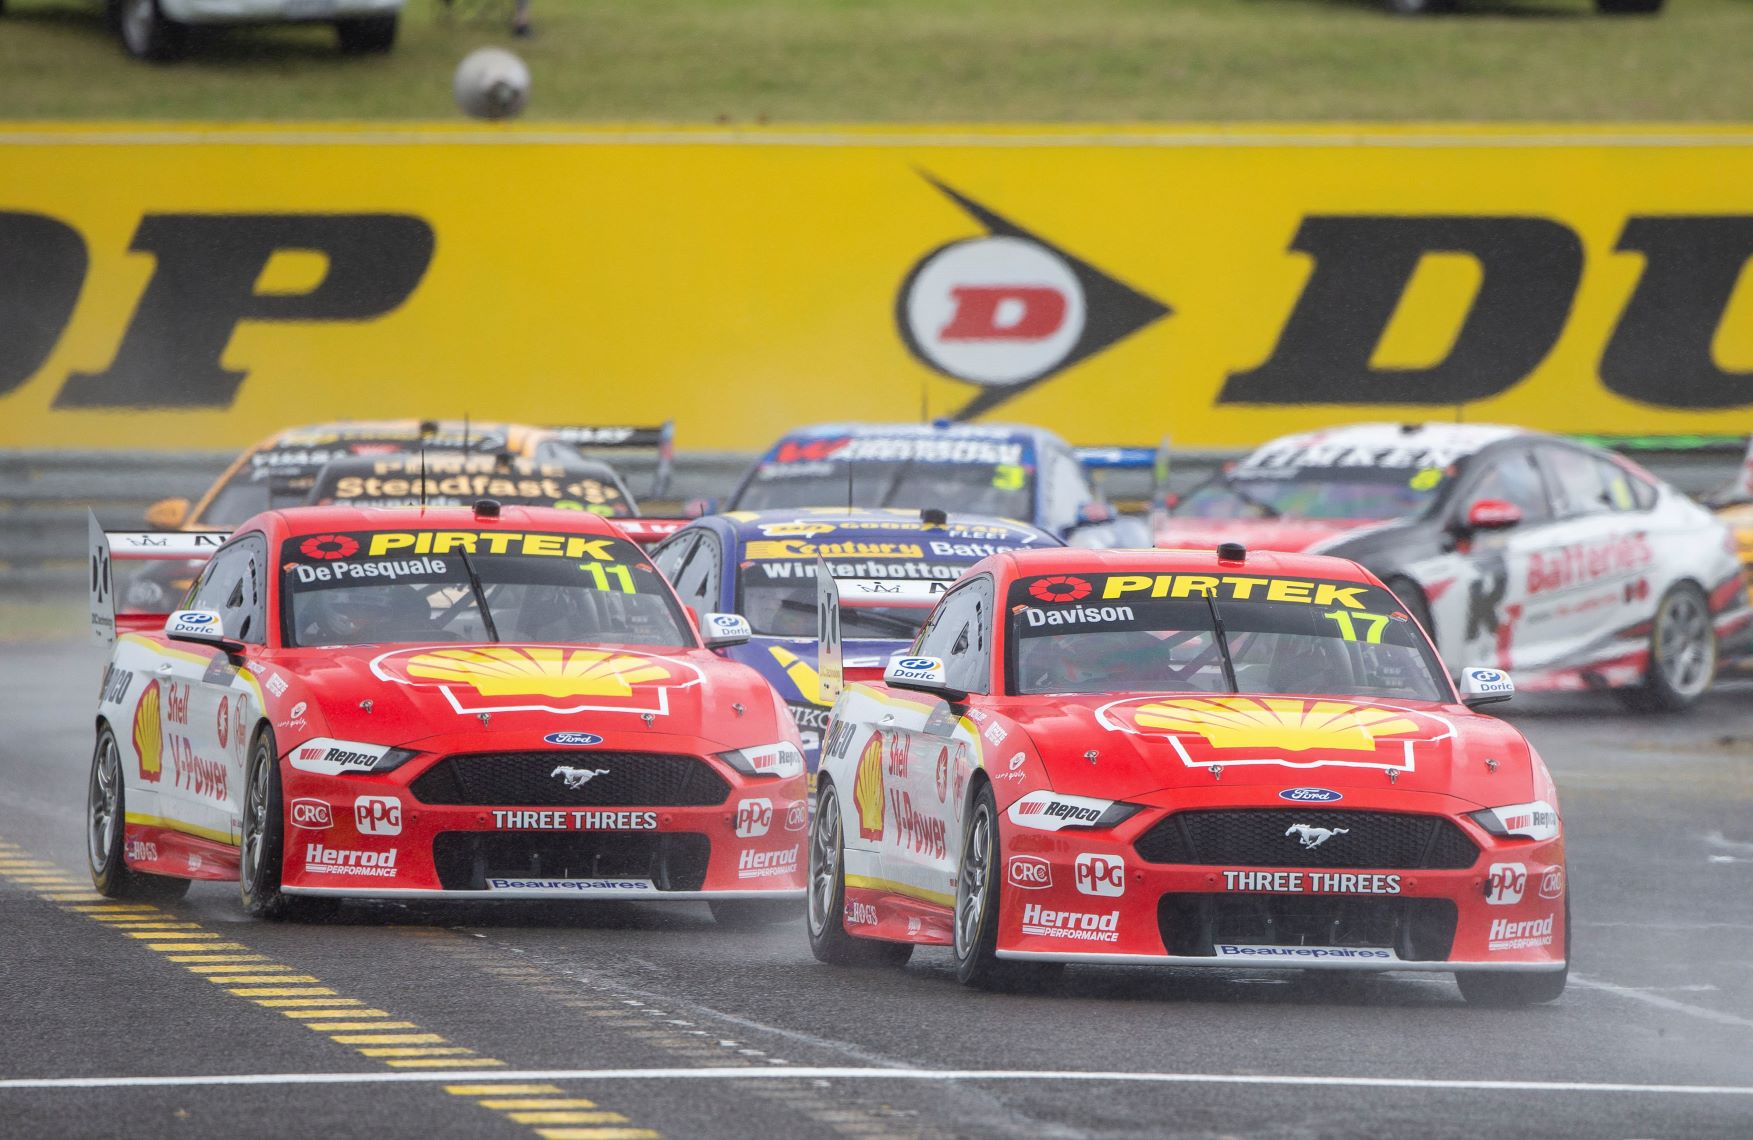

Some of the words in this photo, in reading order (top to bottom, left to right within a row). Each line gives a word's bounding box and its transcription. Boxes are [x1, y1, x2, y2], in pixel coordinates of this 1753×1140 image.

[336, 475, 563, 498] Steadfast
[369, 531, 615, 561] PIRTEK
[784, 540, 924, 558] Century
[929, 541, 1032, 557] Batte
[297, 565, 332, 583] De
[331, 556, 447, 580] Pasquale
[579, 561, 637, 595] 11
[1102, 575, 1369, 609] PIRTEK
[1027, 604, 1135, 627] Davison
[1324, 610, 1390, 644] 17
[175, 624, 214, 634] Doric
[722, 628, 751, 636] Doric
[893, 669, 935, 680] Doric
[1480, 681, 1512, 692] Doric
[167, 681, 190, 725] Shell
[555, 733, 592, 744] Ford
[324, 747, 378, 767] Repco
[889, 731, 911, 778] Shell
[169, 732, 228, 801] V-Power
[1291, 788, 1330, 800] Ford
[294, 804, 328, 823] CRC
[356, 799, 400, 831] PPG
[492, 810, 567, 829] THREE
[571, 811, 657, 830] THREES
[738, 802, 772, 834] PPG
[1044, 800, 1101, 822] Repco
[889, 787, 946, 860] V-Power
[134, 841, 158, 861] HOGS
[306, 843, 398, 868] Herrod
[738, 844, 799, 869] Herrod
[326, 864, 397, 877] PERFORMANCE
[1011, 863, 1048, 883] CRC
[1077, 857, 1123, 892] PPG
[492, 879, 649, 890] Beaurepaires
[1223, 871, 1304, 892] THREE
[1308, 872, 1401, 894] THREES
[853, 902, 878, 926] HOGS
[1022, 903, 1120, 930] Herrod
[1044, 927, 1119, 942] PERFORMANCE
[1489, 913, 1554, 940] Herrod
[1221, 945, 1390, 958] Beaurepaires
